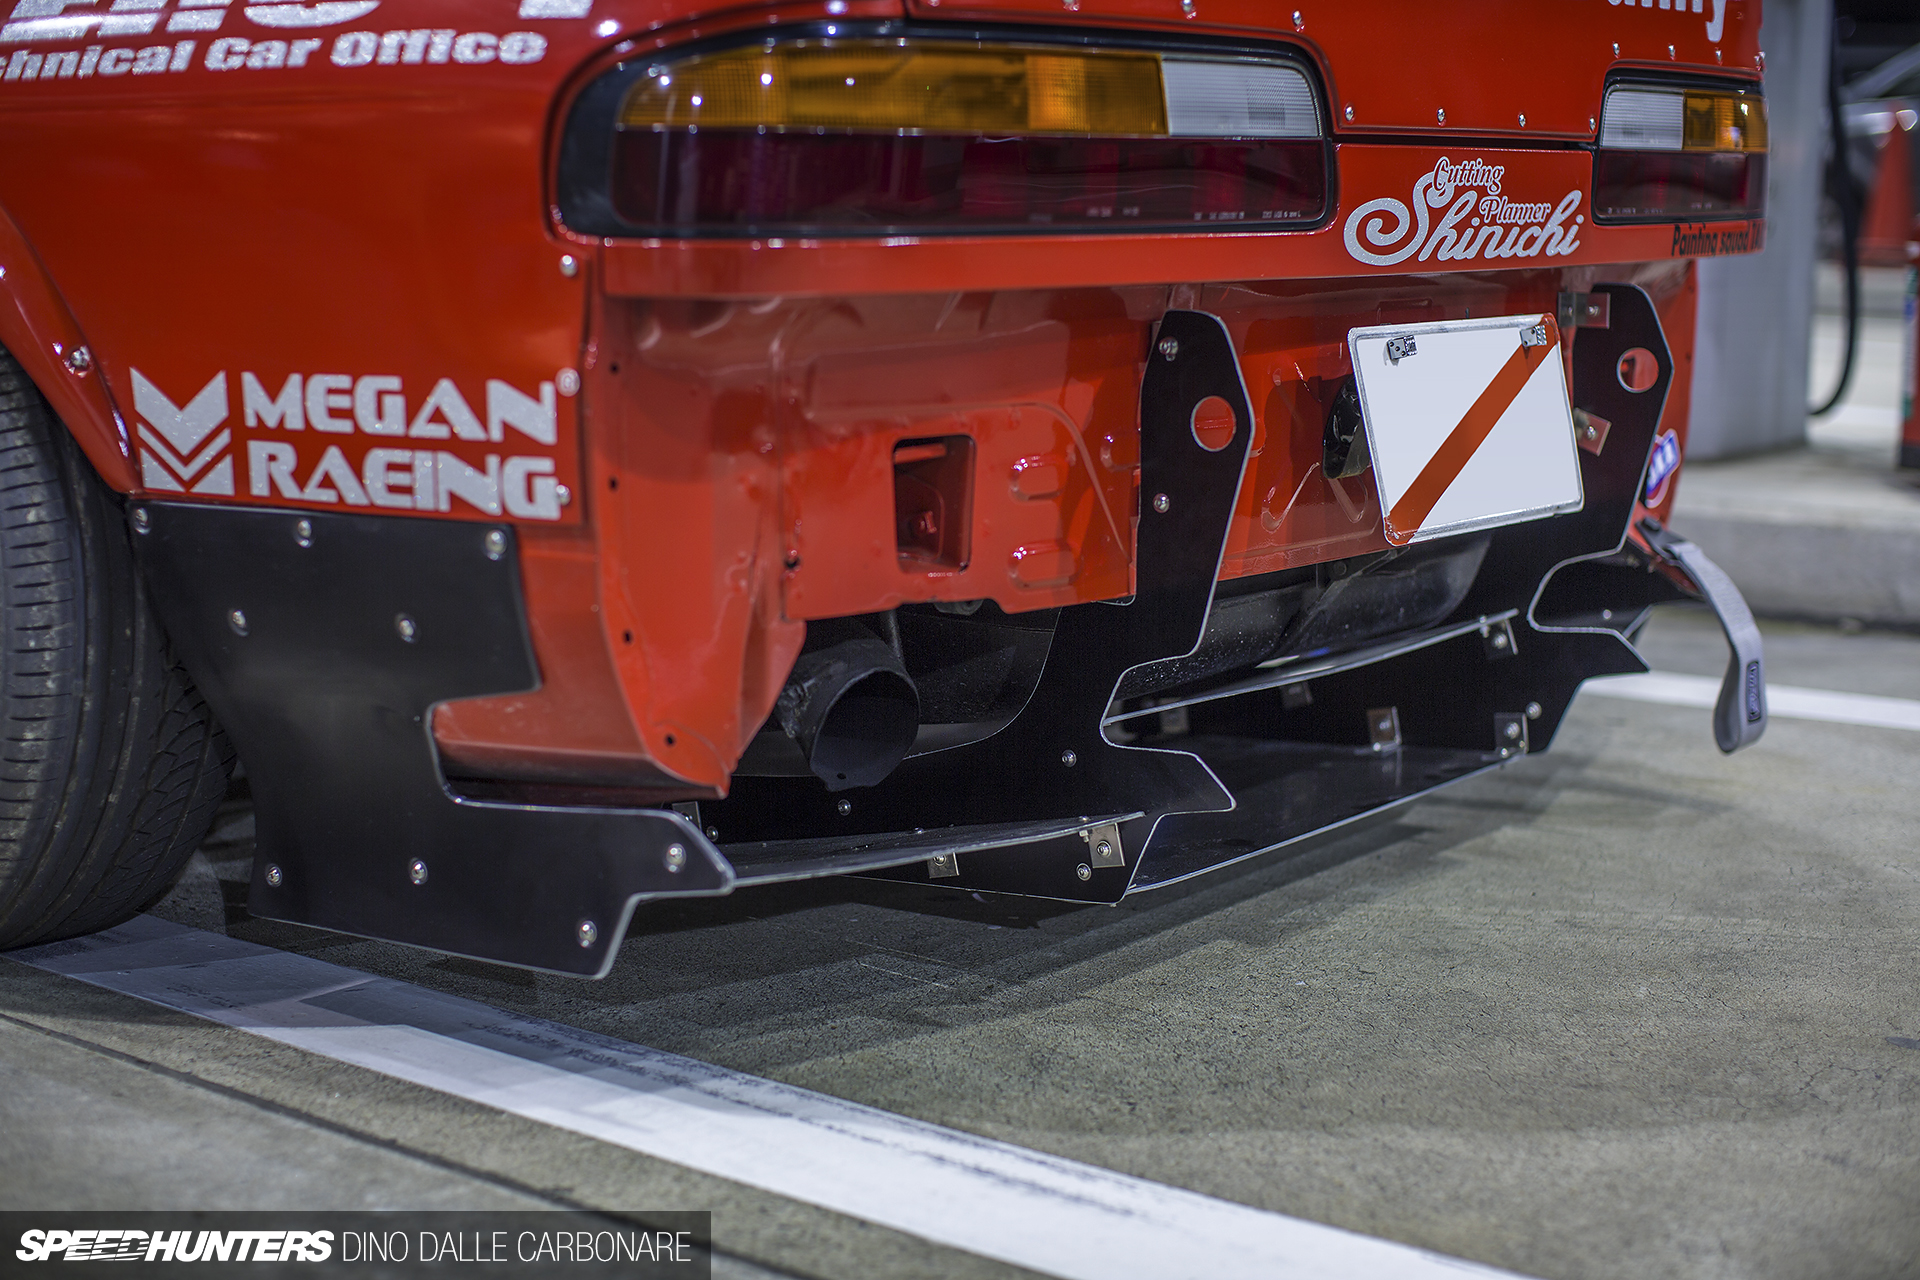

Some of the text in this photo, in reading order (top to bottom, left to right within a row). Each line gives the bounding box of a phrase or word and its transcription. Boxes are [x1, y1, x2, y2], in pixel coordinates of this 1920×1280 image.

[0, 29, 549, 82] hnical Car Office
[1432, 156, 1504, 195] Cutting
[1343, 171, 1585, 266] Shinichi
[1478, 195, 1551, 224] Planner
[1671, 222, 1718, 257] Painting
[241, 371, 557, 446] MEGAN
